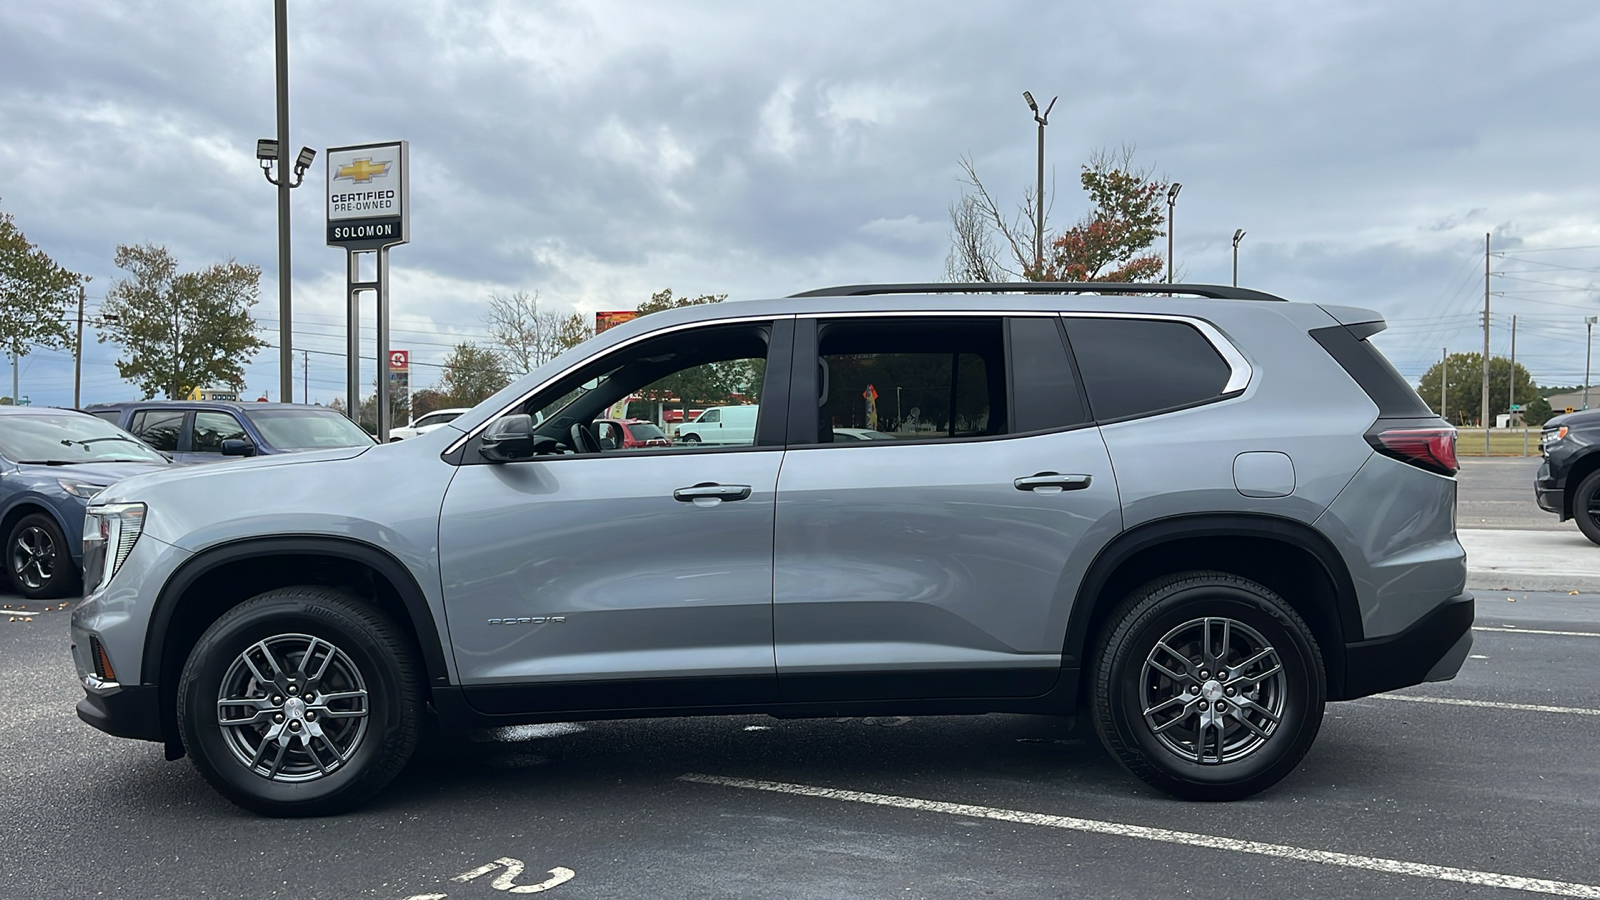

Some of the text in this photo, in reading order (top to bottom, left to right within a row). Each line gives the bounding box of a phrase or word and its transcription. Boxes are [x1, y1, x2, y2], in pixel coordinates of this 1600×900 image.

[331, 190, 395, 203] CERTIFIED
[334, 199, 392, 212] PRE-OWNED
[334, 224, 392, 238] SOLOMON
